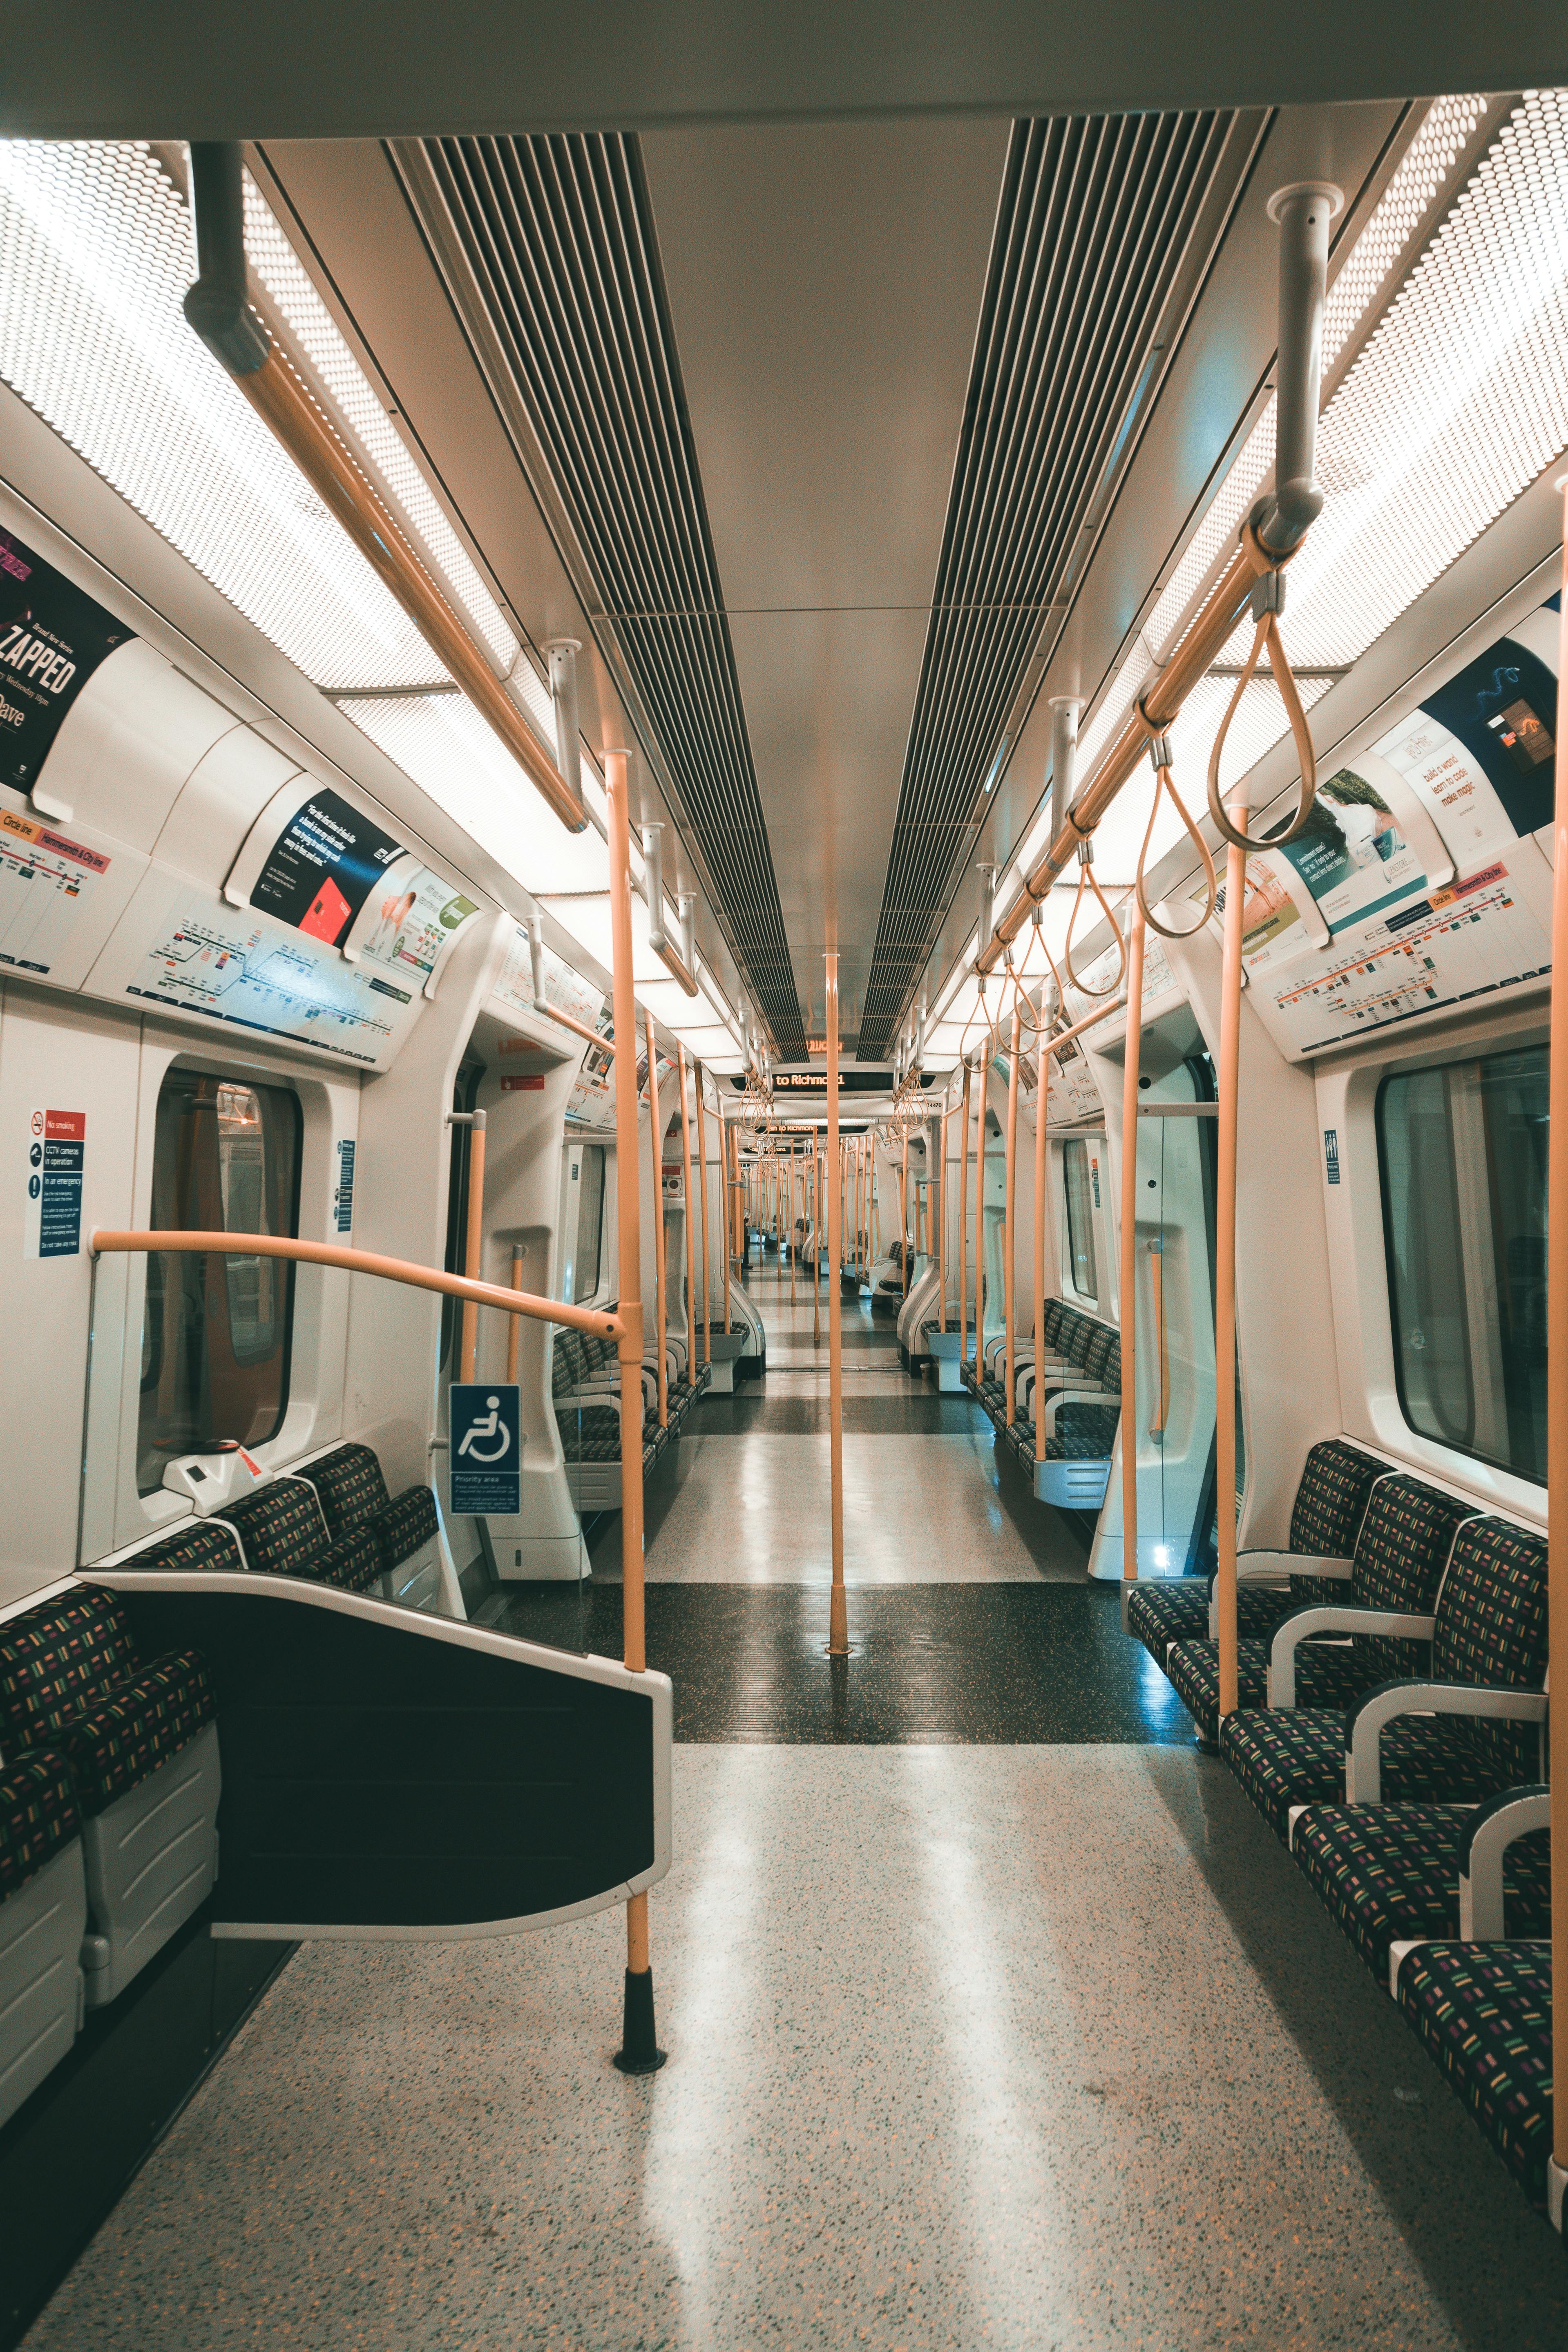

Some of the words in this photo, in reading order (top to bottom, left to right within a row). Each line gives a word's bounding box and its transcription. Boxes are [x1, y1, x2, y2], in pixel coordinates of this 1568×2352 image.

[0, 625, 76, 694] ZAPPED
[6, 675, 35, 698] Wednesday
[1421, 766, 1438, 782] build
[1441, 753, 1458, 770] wand
[1430, 782, 1448, 795] learn
[1445, 777, 1454, 786] to
[1453, 767, 1468, 781] code
[1441, 793, 1458, 807] make
[1457, 780, 1475, 797] magic
[3, 816, 21, 831] Circle
[20, 823, 33, 835] line
[41, 833, 79, 855] Hammersmith
[83, 852, 94, 865] City
[93, 856, 104, 868] line
[1297, 847, 1317, 865] Commitment
[1433, 896, 1443, 905] Circle
[1455, 877, 1483, 894] Hammersmith
[1493, 868, 1502, 876] line
[776, 1076, 789, 1085] to
[791, 1074, 844, 1085] Richmod.
[47, 1120, 54, 1128] No
[56, 1122, 76, 1132] smoking
[51, 1158, 73, 1166] operation
[455, 1476, 482, 1484] Priority
